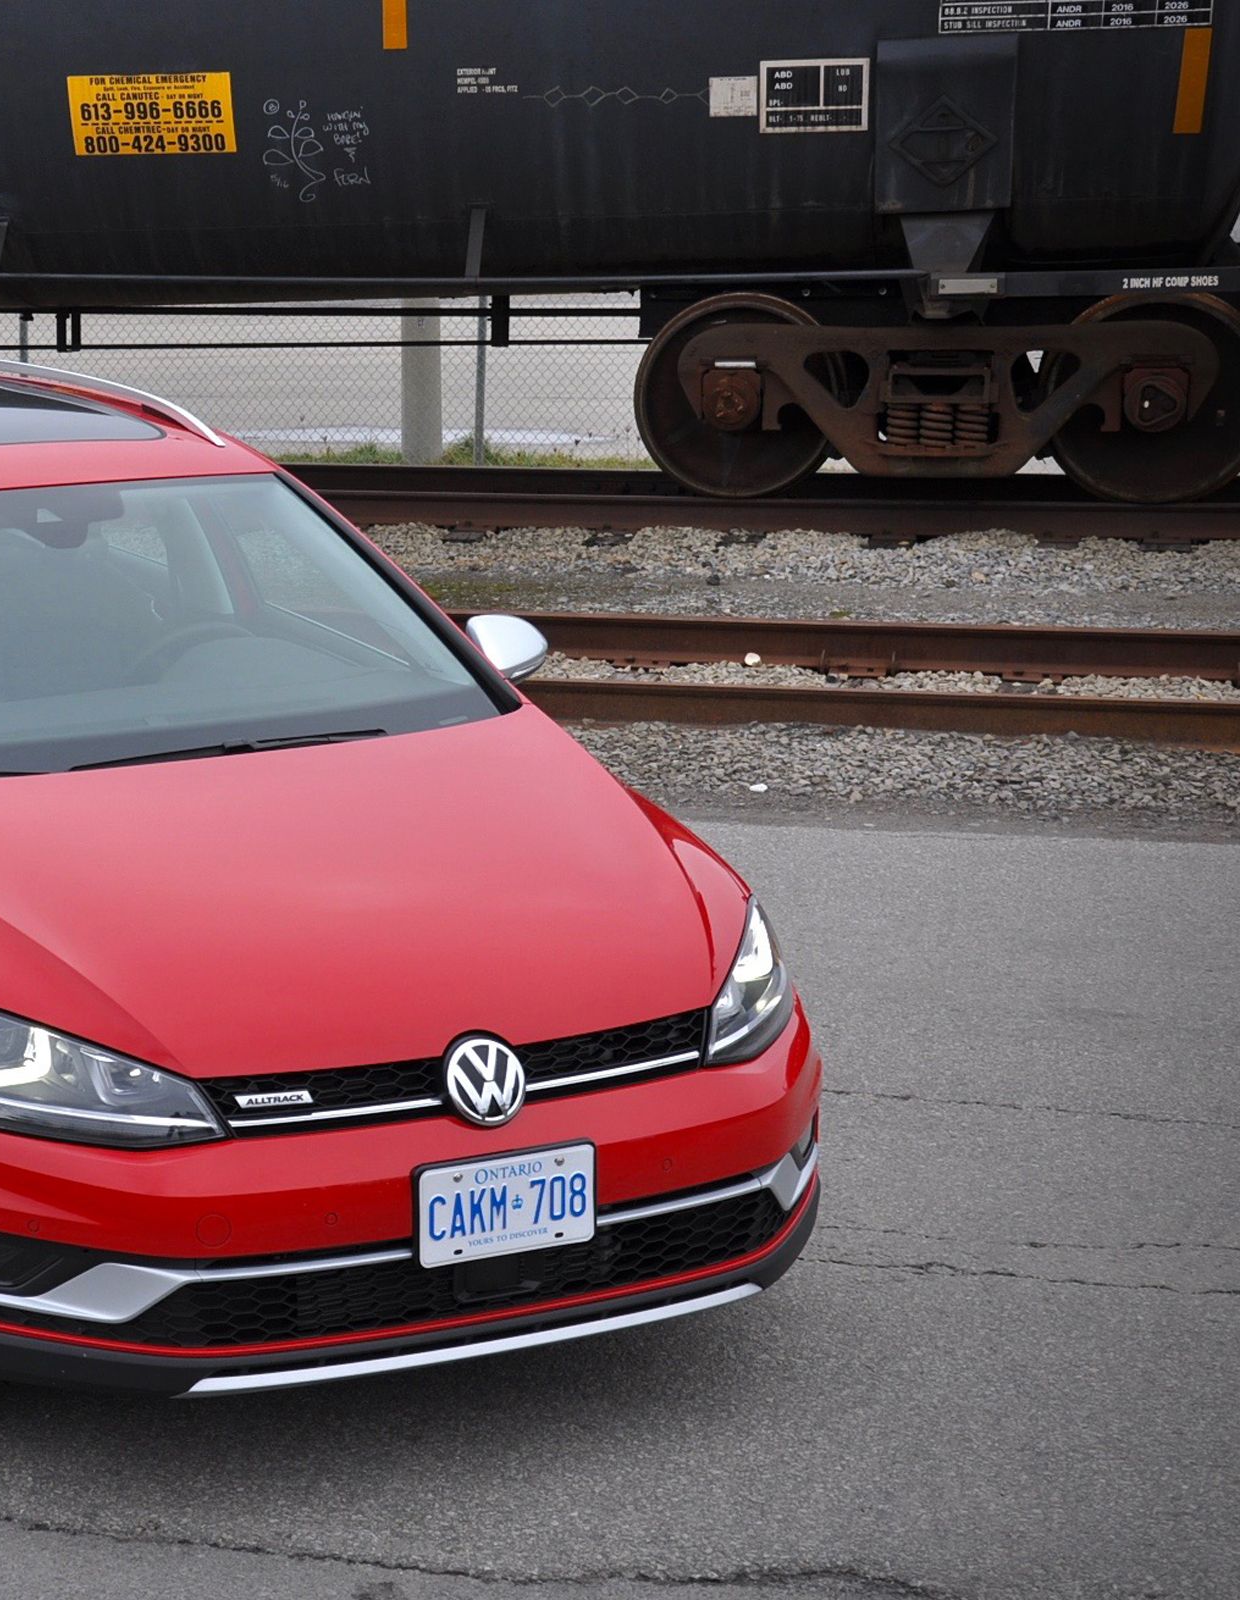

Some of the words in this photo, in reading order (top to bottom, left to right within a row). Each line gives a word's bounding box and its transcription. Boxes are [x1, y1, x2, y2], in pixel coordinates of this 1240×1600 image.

[971, 5, 1013, 14] INSPECTION
[1056, 5, 1082, 13] ANDR
[1111, 3, 1134, 11] 2016
[1164, 1, 1189, 9] 2026
[944, 21, 962, 29] STUB
[1056, 19, 1082, 28] ANDR
[1110, 17, 1132, 26] 2016
[1163, 15, 1188, 23] 2026
[89, 77, 106, 85] FOR
[109, 75, 152, 85] CHEMICAL
[155, 74, 207, 84] EMERGENCY
[774, 70, 793, 79] ABD
[774, 82, 793, 90] ABD
[95, 92, 117, 101] CALL
[119, 91, 160, 101] CANUTEC
[80, 100, 222, 121] 613-996-6666
[95, 126, 117, 135] CALL
[84, 133, 226, 153] 800-424-9300
[1122, 278, 1129, 289] 2
[1129, 277, 1151, 289] INCH
[1151, 276, 1164, 288] HF
[1164, 276, 1189, 288] COMP
[1190, 275, 1219, 287] SHOES
[245, 1093, 305, 1106] ALLTRACK
[428, 1184, 508, 1242] CAKM
[529, 1171, 587, 1225] 708
[468, 1236, 494, 1248] YOURS
[496, 1234, 508, 1244] TO
[509, 1227, 549, 1240] DISCOVER
